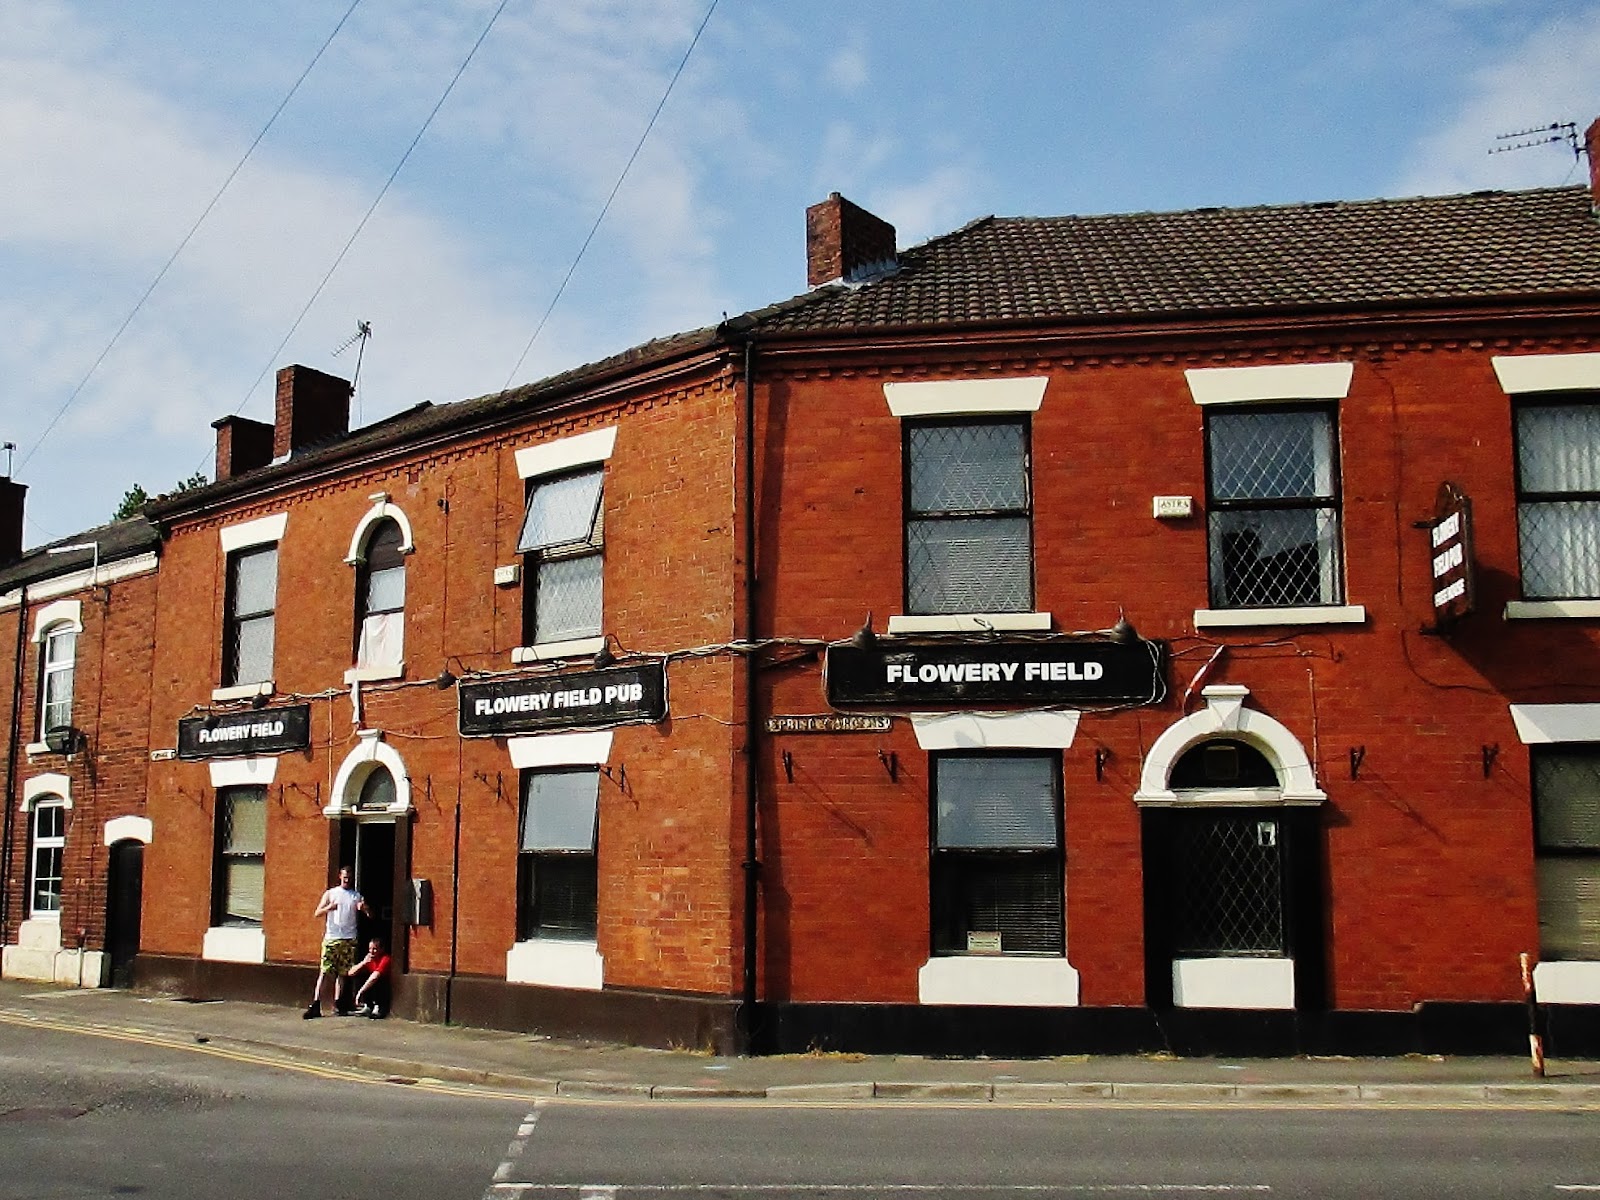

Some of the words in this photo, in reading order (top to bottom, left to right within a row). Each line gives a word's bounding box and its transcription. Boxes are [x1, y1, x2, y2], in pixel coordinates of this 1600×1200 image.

[887, 662, 1019, 683] FLOWERY
[1024, 661, 1103, 681] FIELD
[475, 692, 551, 716] FLOWERY
[553, 687, 602, 709] FIELD
[604, 683, 643, 704] PUB
[199, 724, 250, 743] FLOWERY
[251, 721, 284, 738] FIELD
